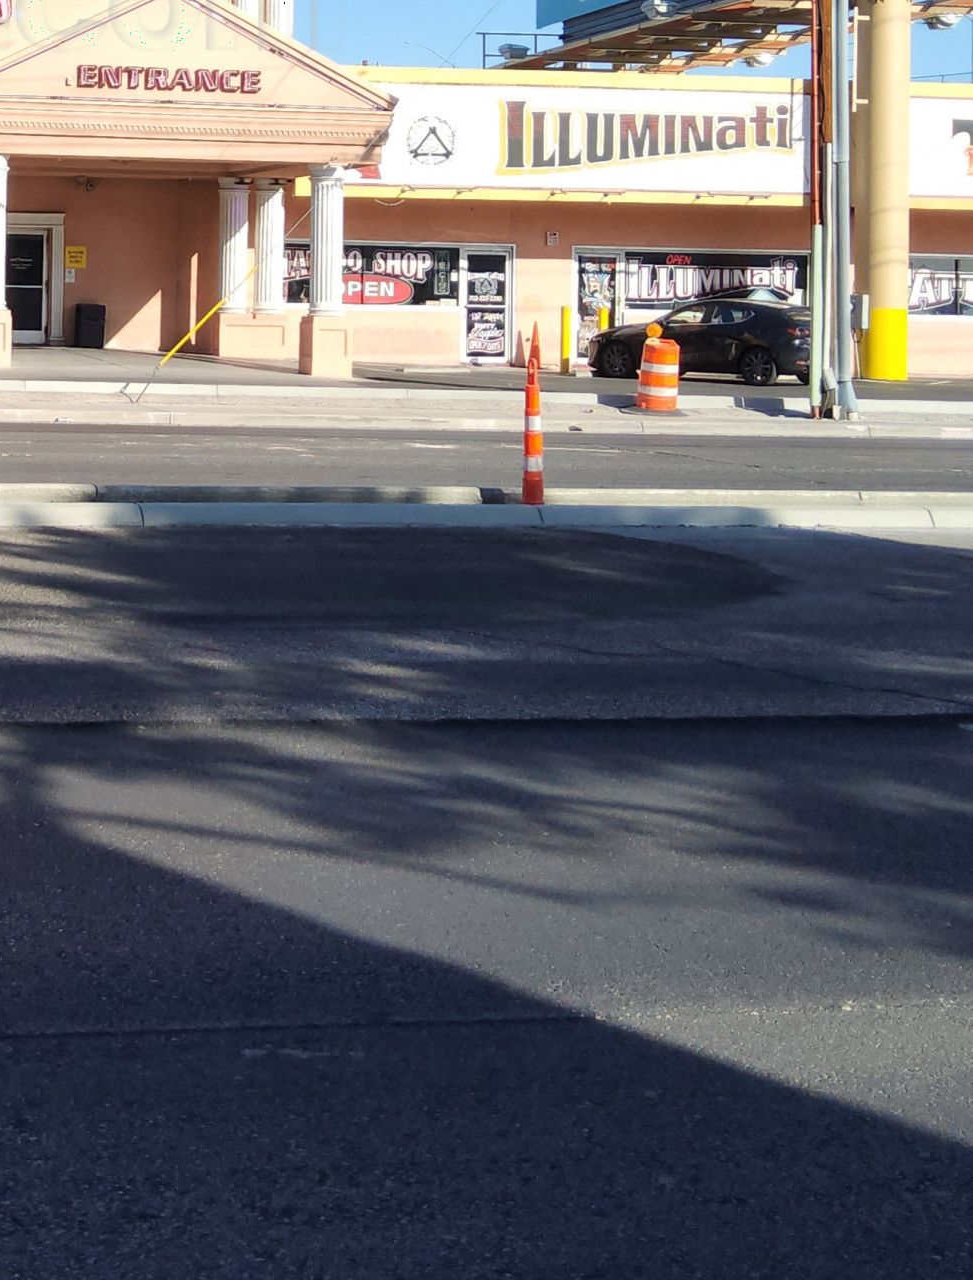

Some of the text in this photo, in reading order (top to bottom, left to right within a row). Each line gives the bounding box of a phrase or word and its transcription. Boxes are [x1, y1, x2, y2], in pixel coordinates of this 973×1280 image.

[77, 65, 262, 94] ENTRANCE
[374, 251, 432, 281] SHOP
[666, 255, 691, 265] OPEN
[342, 280, 396, 297] PEN
[908, 270, 973, 313] ATT
